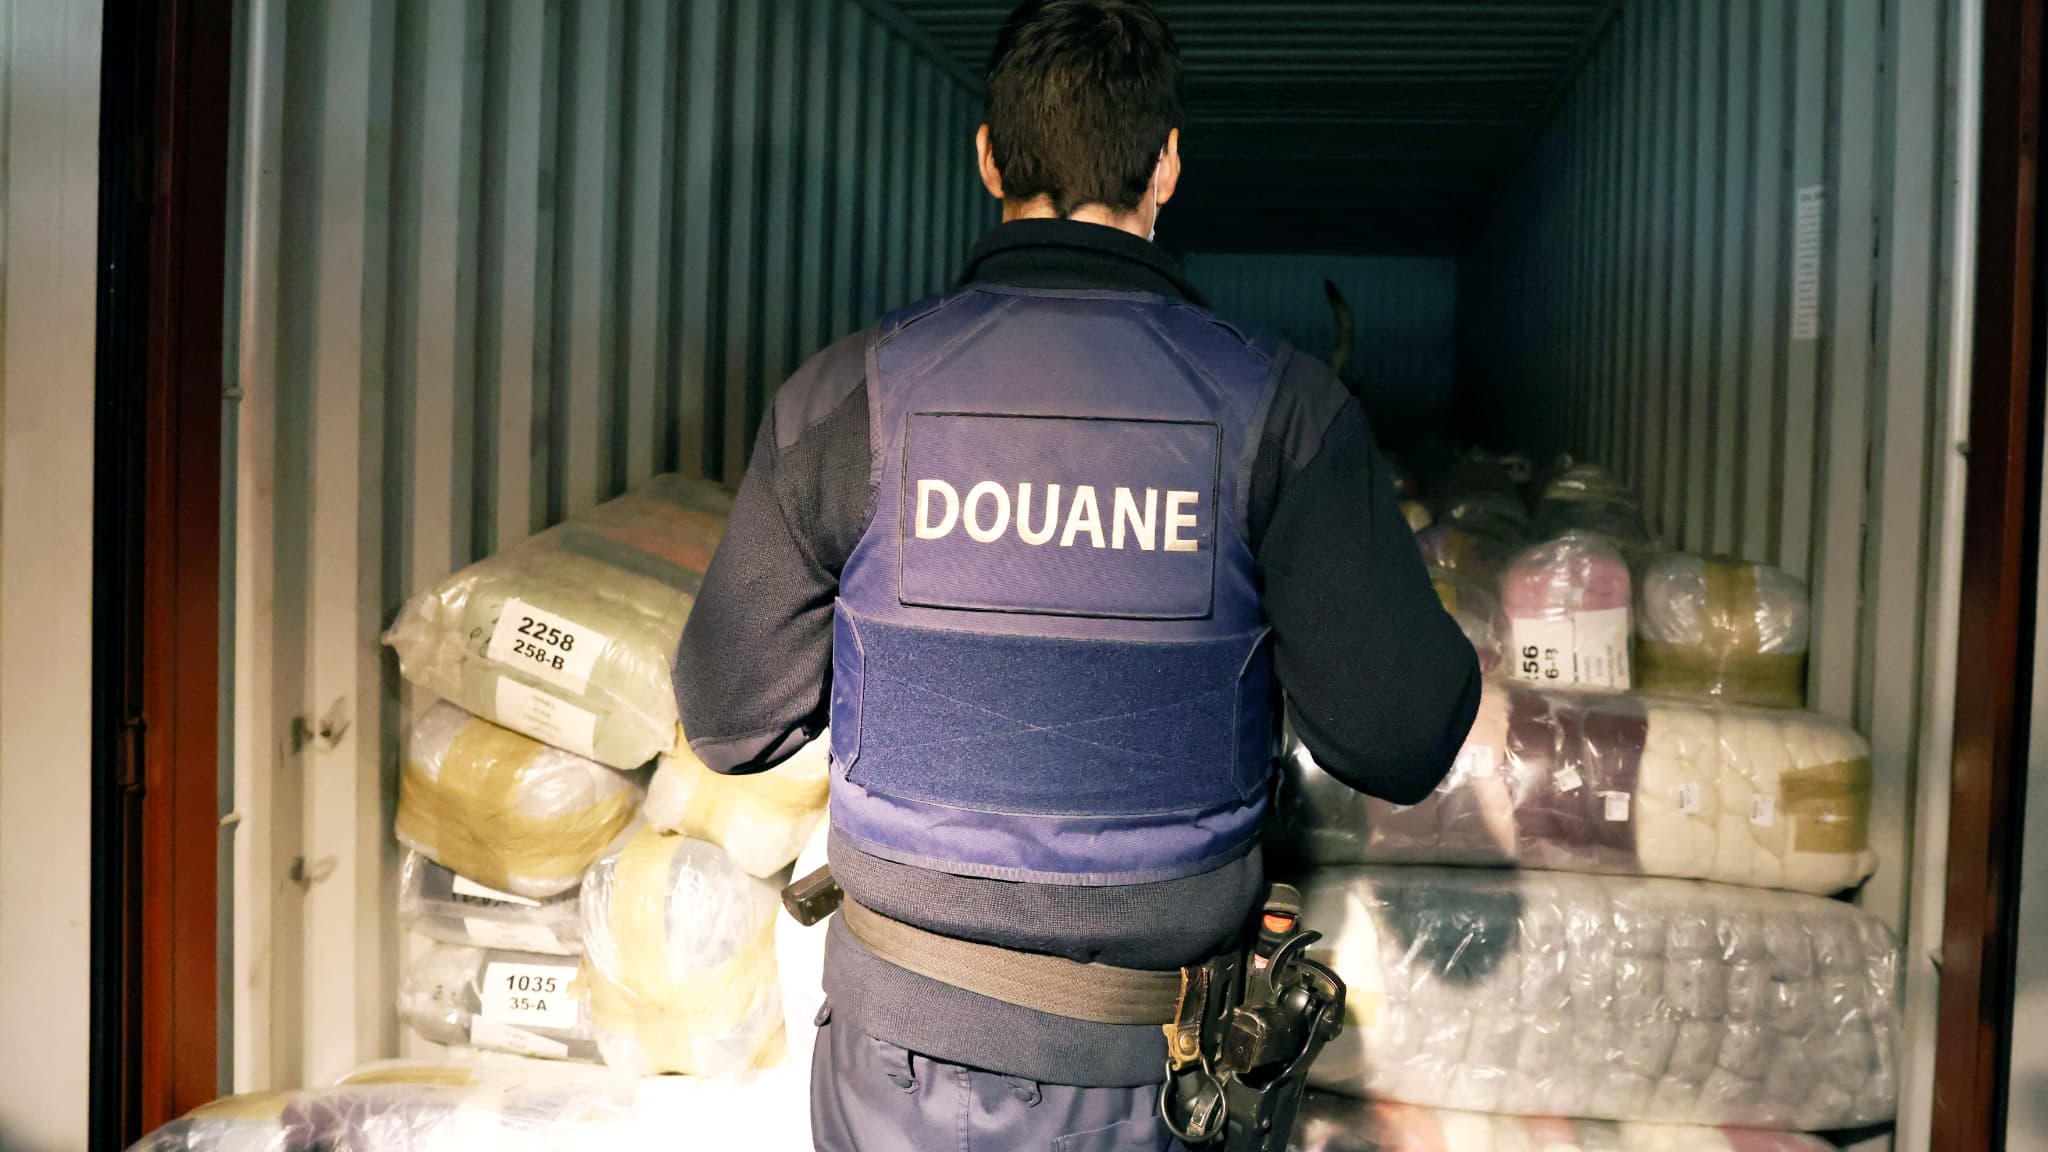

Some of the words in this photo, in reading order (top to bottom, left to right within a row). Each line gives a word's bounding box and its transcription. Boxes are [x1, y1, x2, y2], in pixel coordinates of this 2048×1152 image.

[915, 479, 1199, 552] DOUANE
[518, 616, 575, 652] 2258
[513, 639, 565, 671] 258-B
[1522, 645, 1539, 680] 56
[506, 975, 558, 993] 1035
[510, 997, 547, 1011] 35-A
